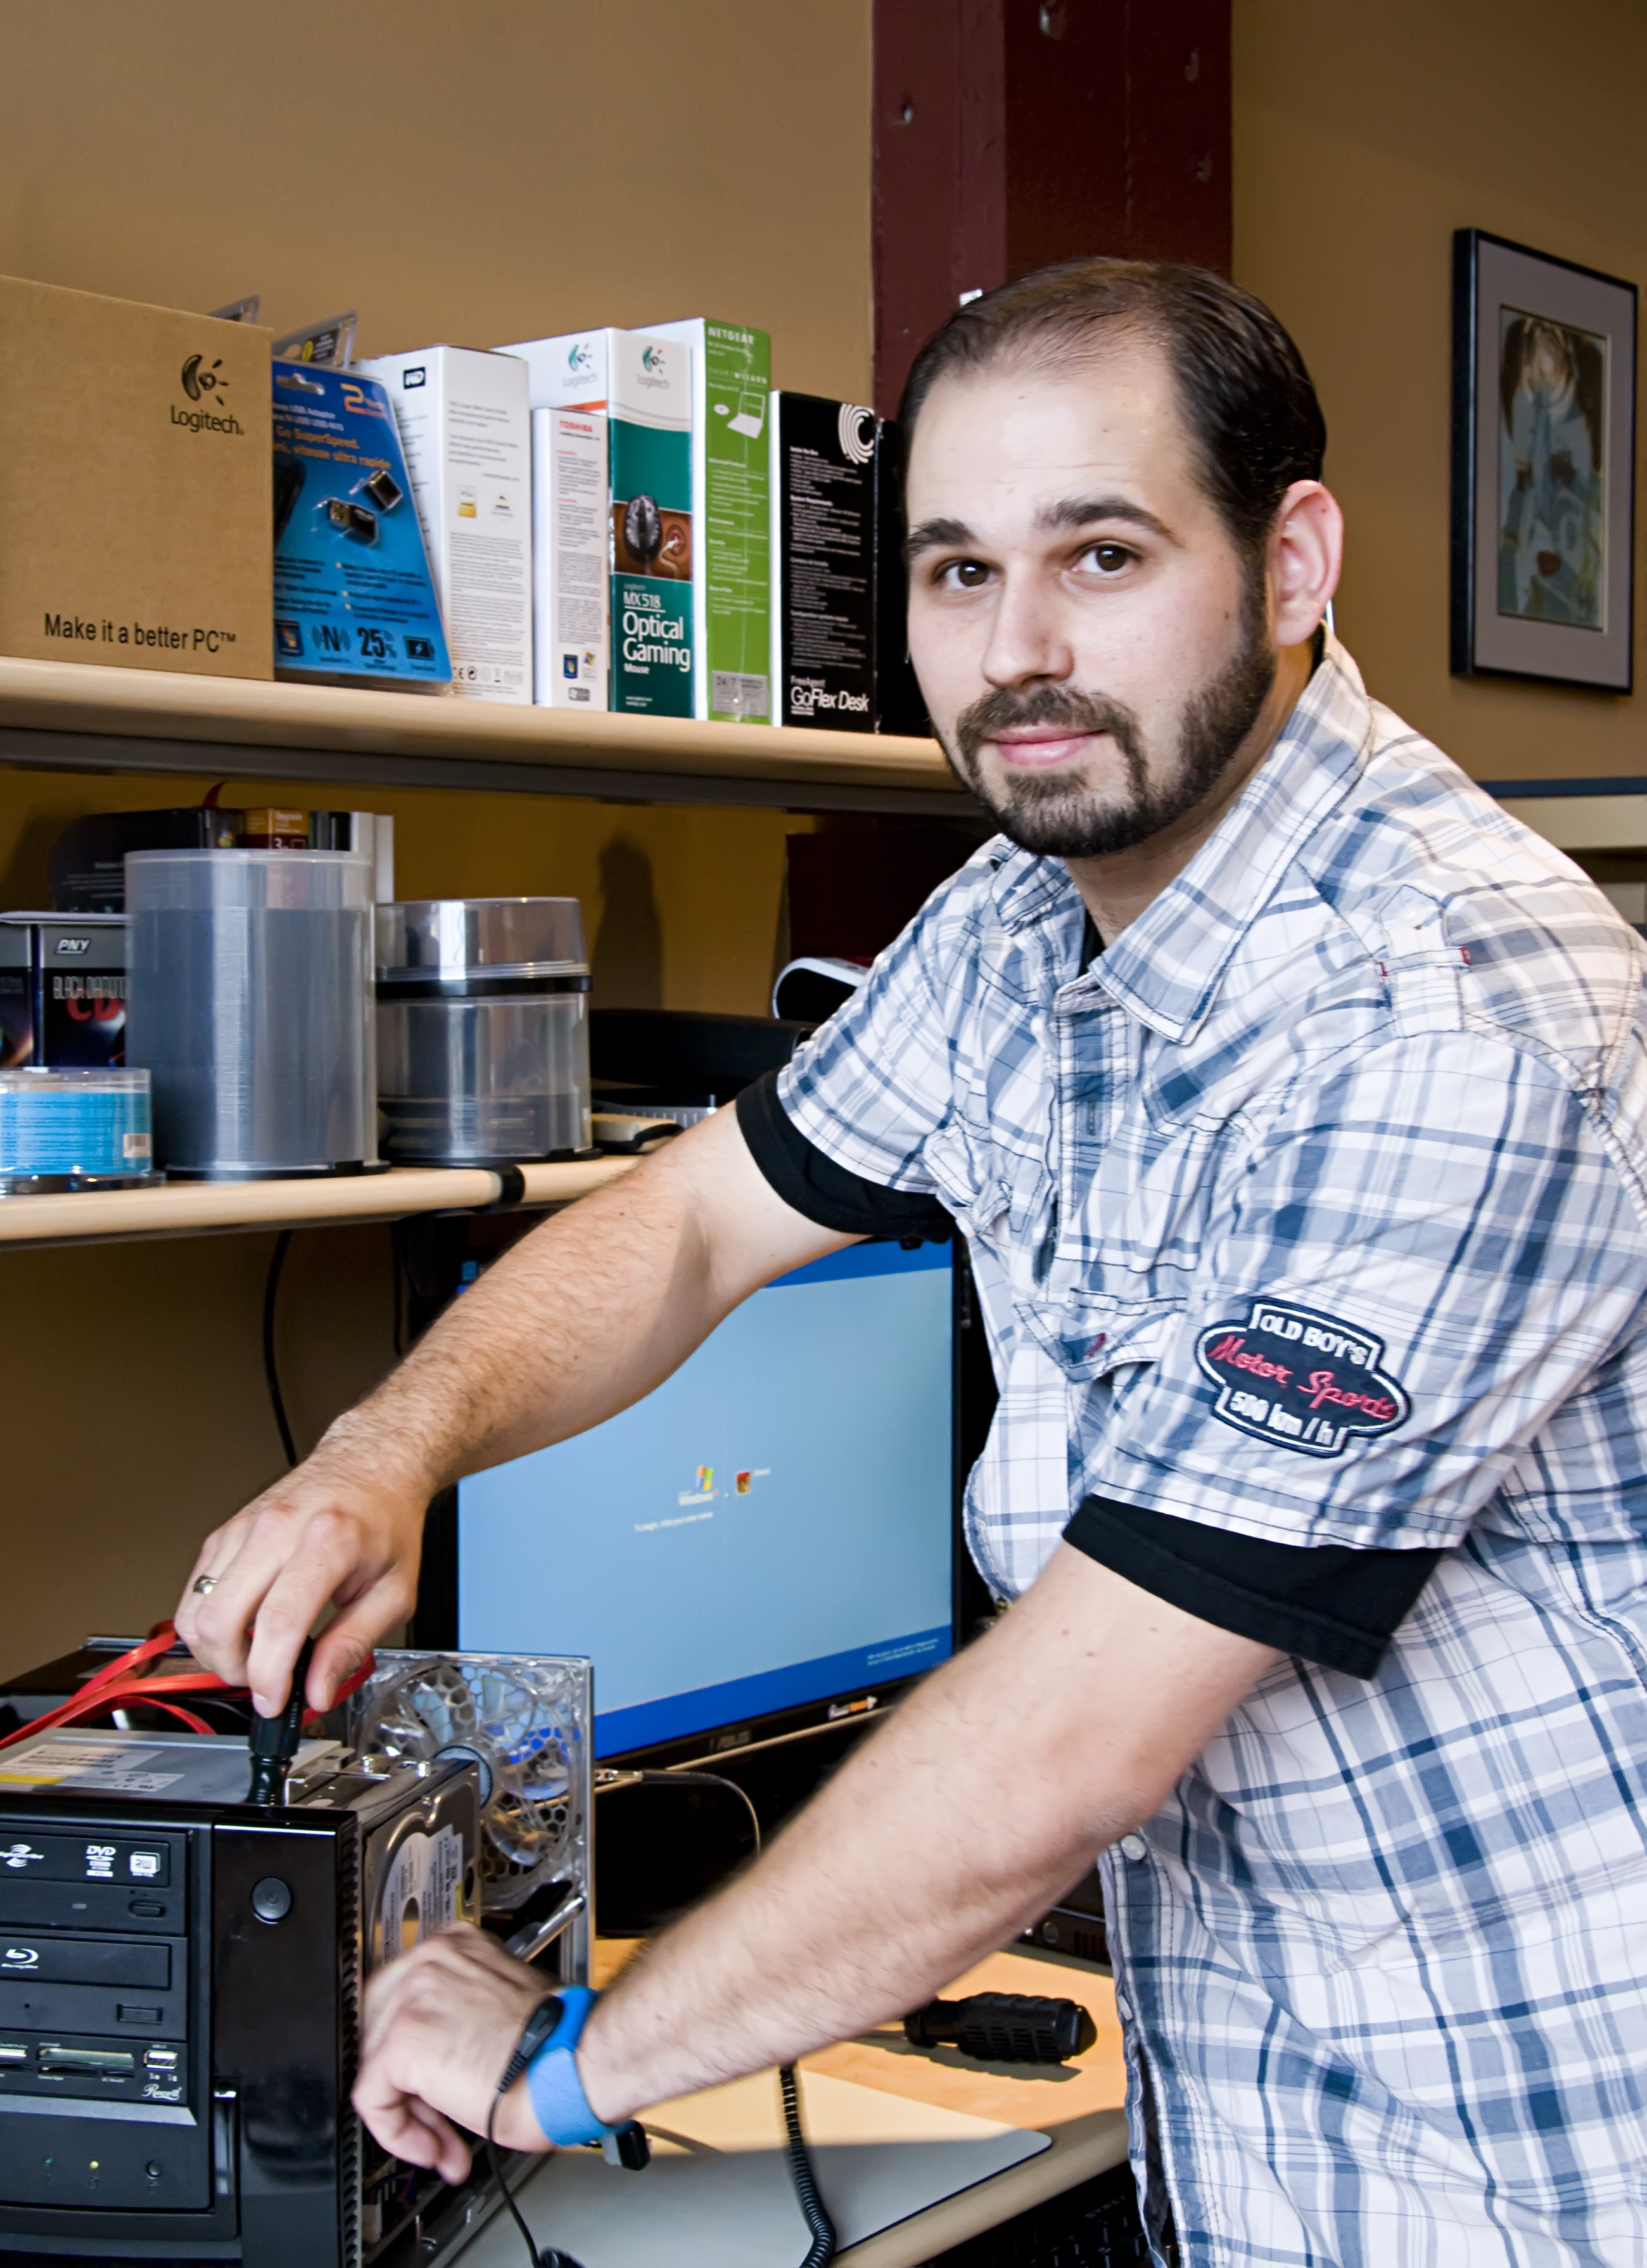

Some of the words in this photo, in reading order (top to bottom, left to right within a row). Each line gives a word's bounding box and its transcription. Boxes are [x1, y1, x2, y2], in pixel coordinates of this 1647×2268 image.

[708, 326, 755, 345] NETGEAR
[170, 404, 243, 435] Logitech
[44, 613, 96, 640] Make
[101, 619, 113, 642] it
[118, 625, 129, 644] a
[134, 621, 189, 649] better
[623, 611, 684, 642] Optical
[623, 637, 691, 673] Gaming
[791, 685, 838, 710] GoFlex
[837, 691, 870, 713] Desk
[58, 938, 90, 950] PNY
[1260, 1314, 1303, 1341] OLD
[1302, 1326, 1369, 1365] BOY'S
[86, 1845, 117, 1856] DVD
